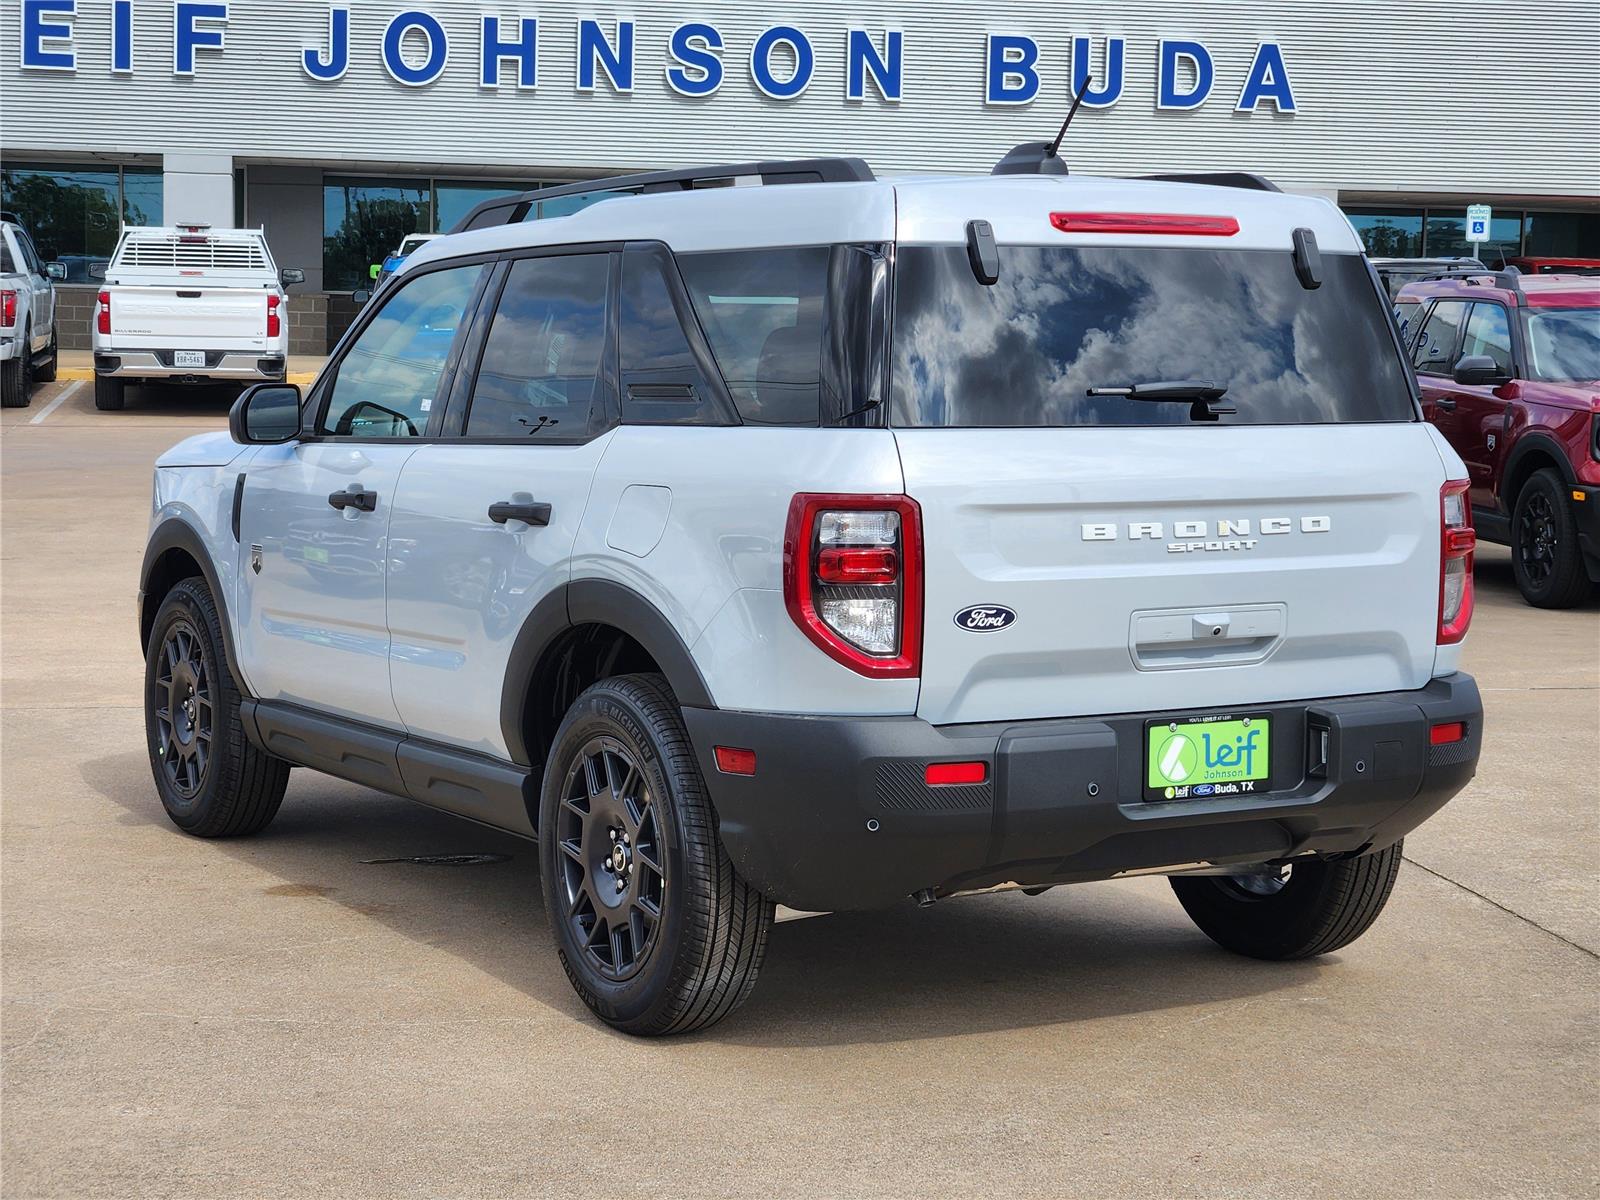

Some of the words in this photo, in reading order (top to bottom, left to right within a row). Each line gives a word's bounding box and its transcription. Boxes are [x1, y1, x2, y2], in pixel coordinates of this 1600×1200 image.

[20, 0, 229, 77] EIF
[301, 7, 904, 103] JOHNSON
[985, 31, 1297, 115] BUDA
[1081, 515, 1331, 541] BRONCO
[1167, 539, 1258, 553] SPORT
[966, 609, 1006, 627] Ford
[609, 706, 654, 761] MICHELIN
[1203, 769, 1243, 780] Johnson
[1215, 783, 1239, 794] Buda,
[1241, 781, 1254, 791] TX
